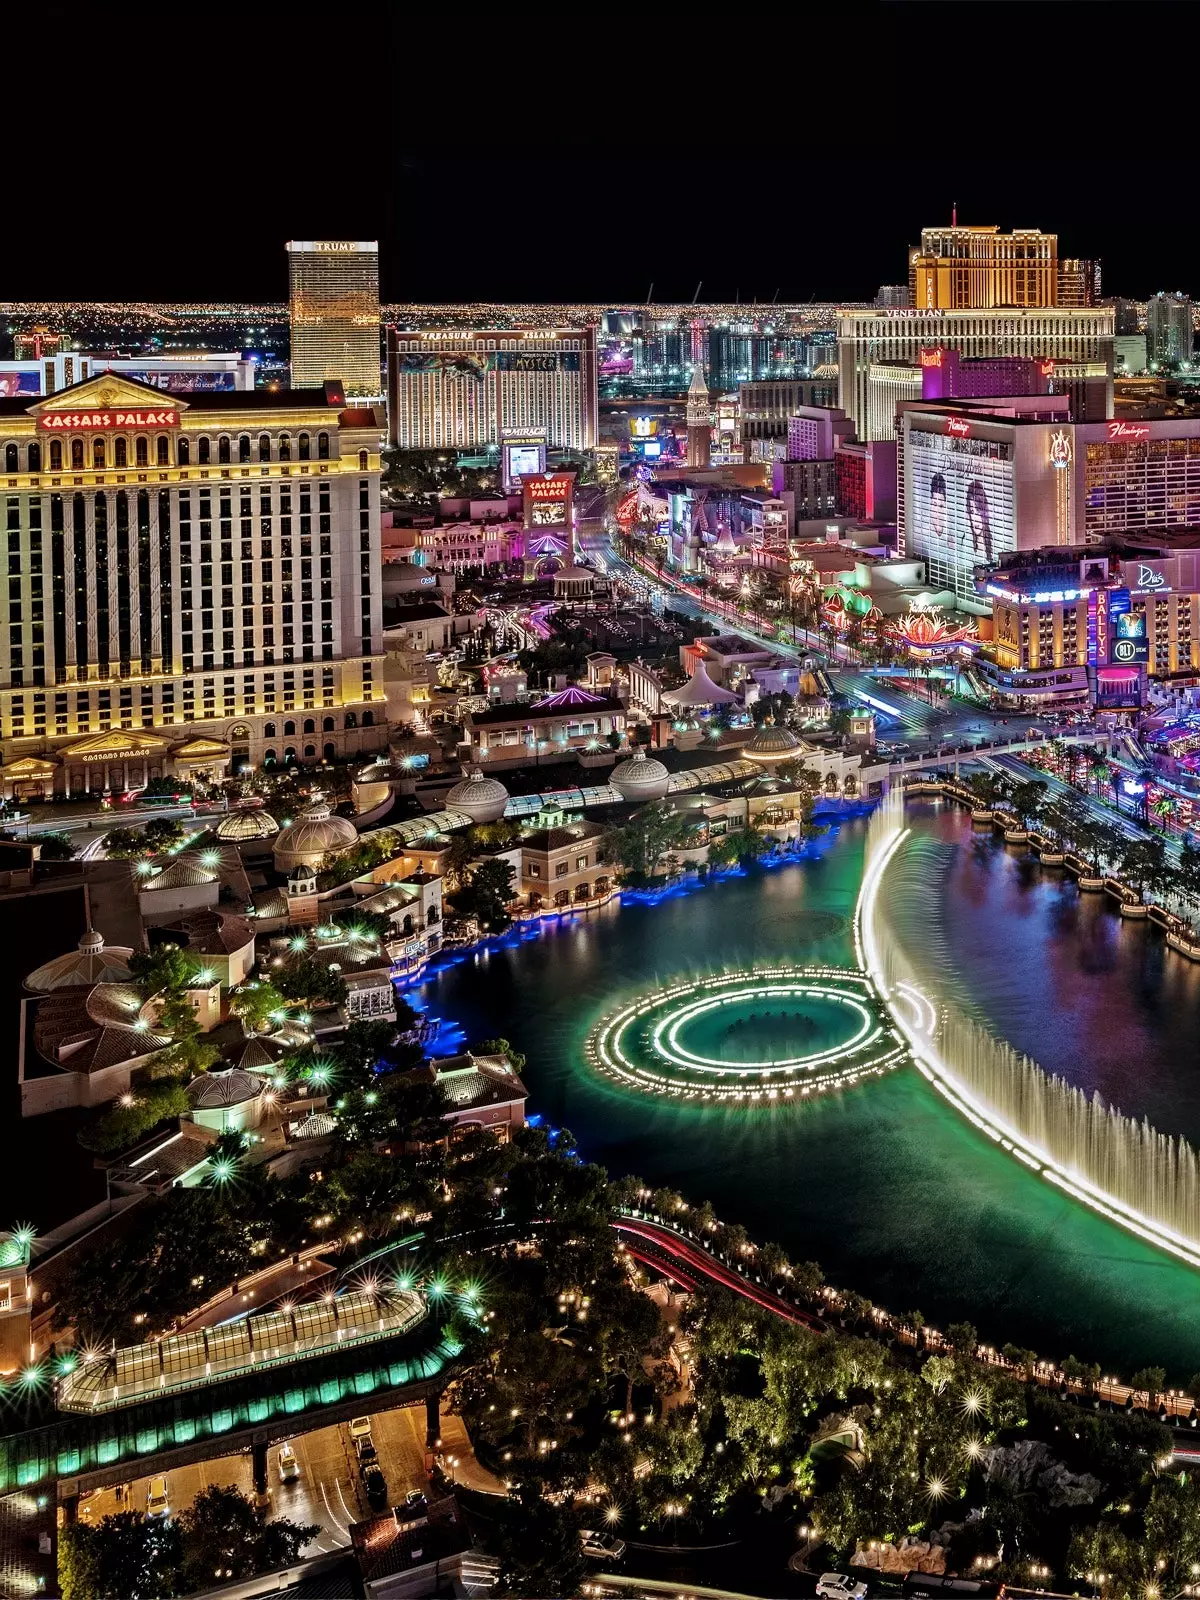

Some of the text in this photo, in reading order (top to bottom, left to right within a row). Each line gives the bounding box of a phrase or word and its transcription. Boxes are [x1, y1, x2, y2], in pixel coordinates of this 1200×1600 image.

[316, 242, 356, 252] TRUMP
[886, 309, 942, 318] VENETIAN
[422, 331, 557, 340] TREASURE ISLAND
[42, 412, 175, 428] CAESARS PALACE
[1108, 422, 1150, 437] Flamingo
[529, 481, 567, 489] CAESARS
[531, 489, 565, 497] PALACE
[1097, 594, 1106, 657] BALLYS
[1119, 644, 1131, 656] BLT
